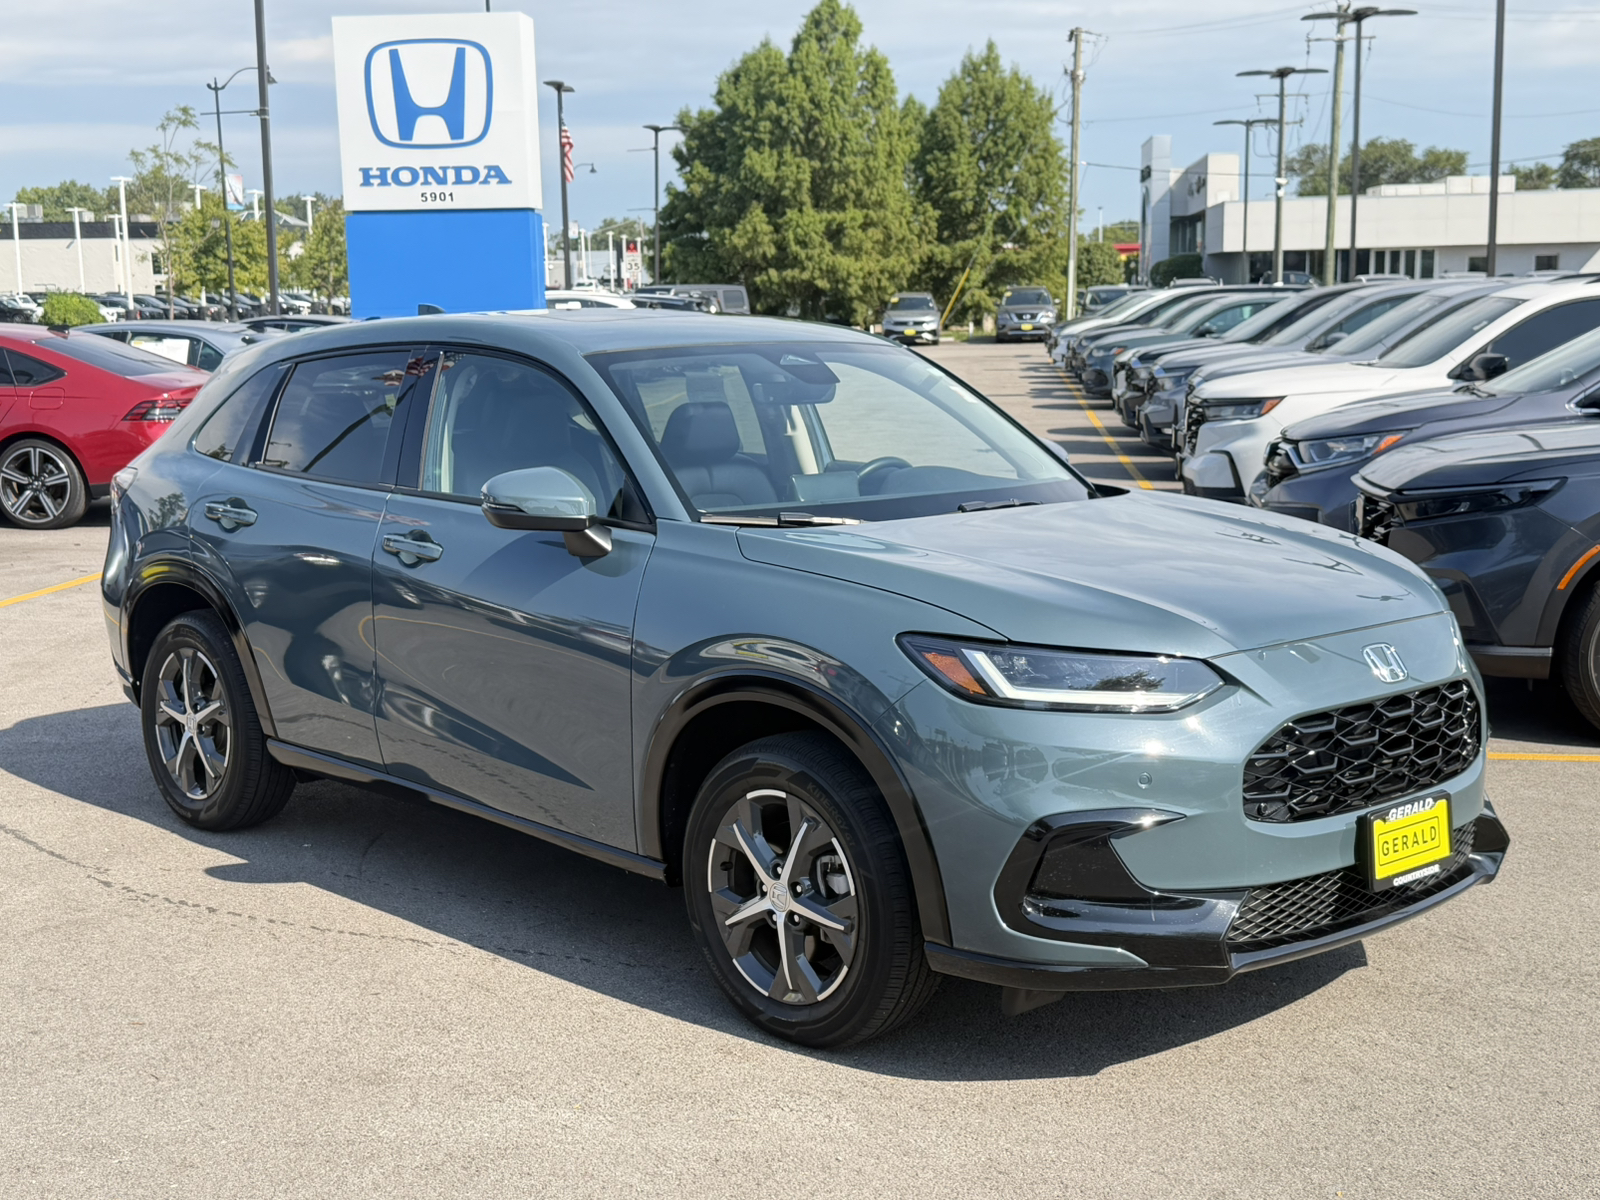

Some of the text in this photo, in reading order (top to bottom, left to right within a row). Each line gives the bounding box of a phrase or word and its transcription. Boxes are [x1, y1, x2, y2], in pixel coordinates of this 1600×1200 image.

[358, 165, 513, 187] HONDA
[420, 192, 455, 202] 5901
[806, 782, 850, 830] KINERGY
[1388, 798, 1434, 820] GERALD
[1382, 826, 1437, 856] GERALD
